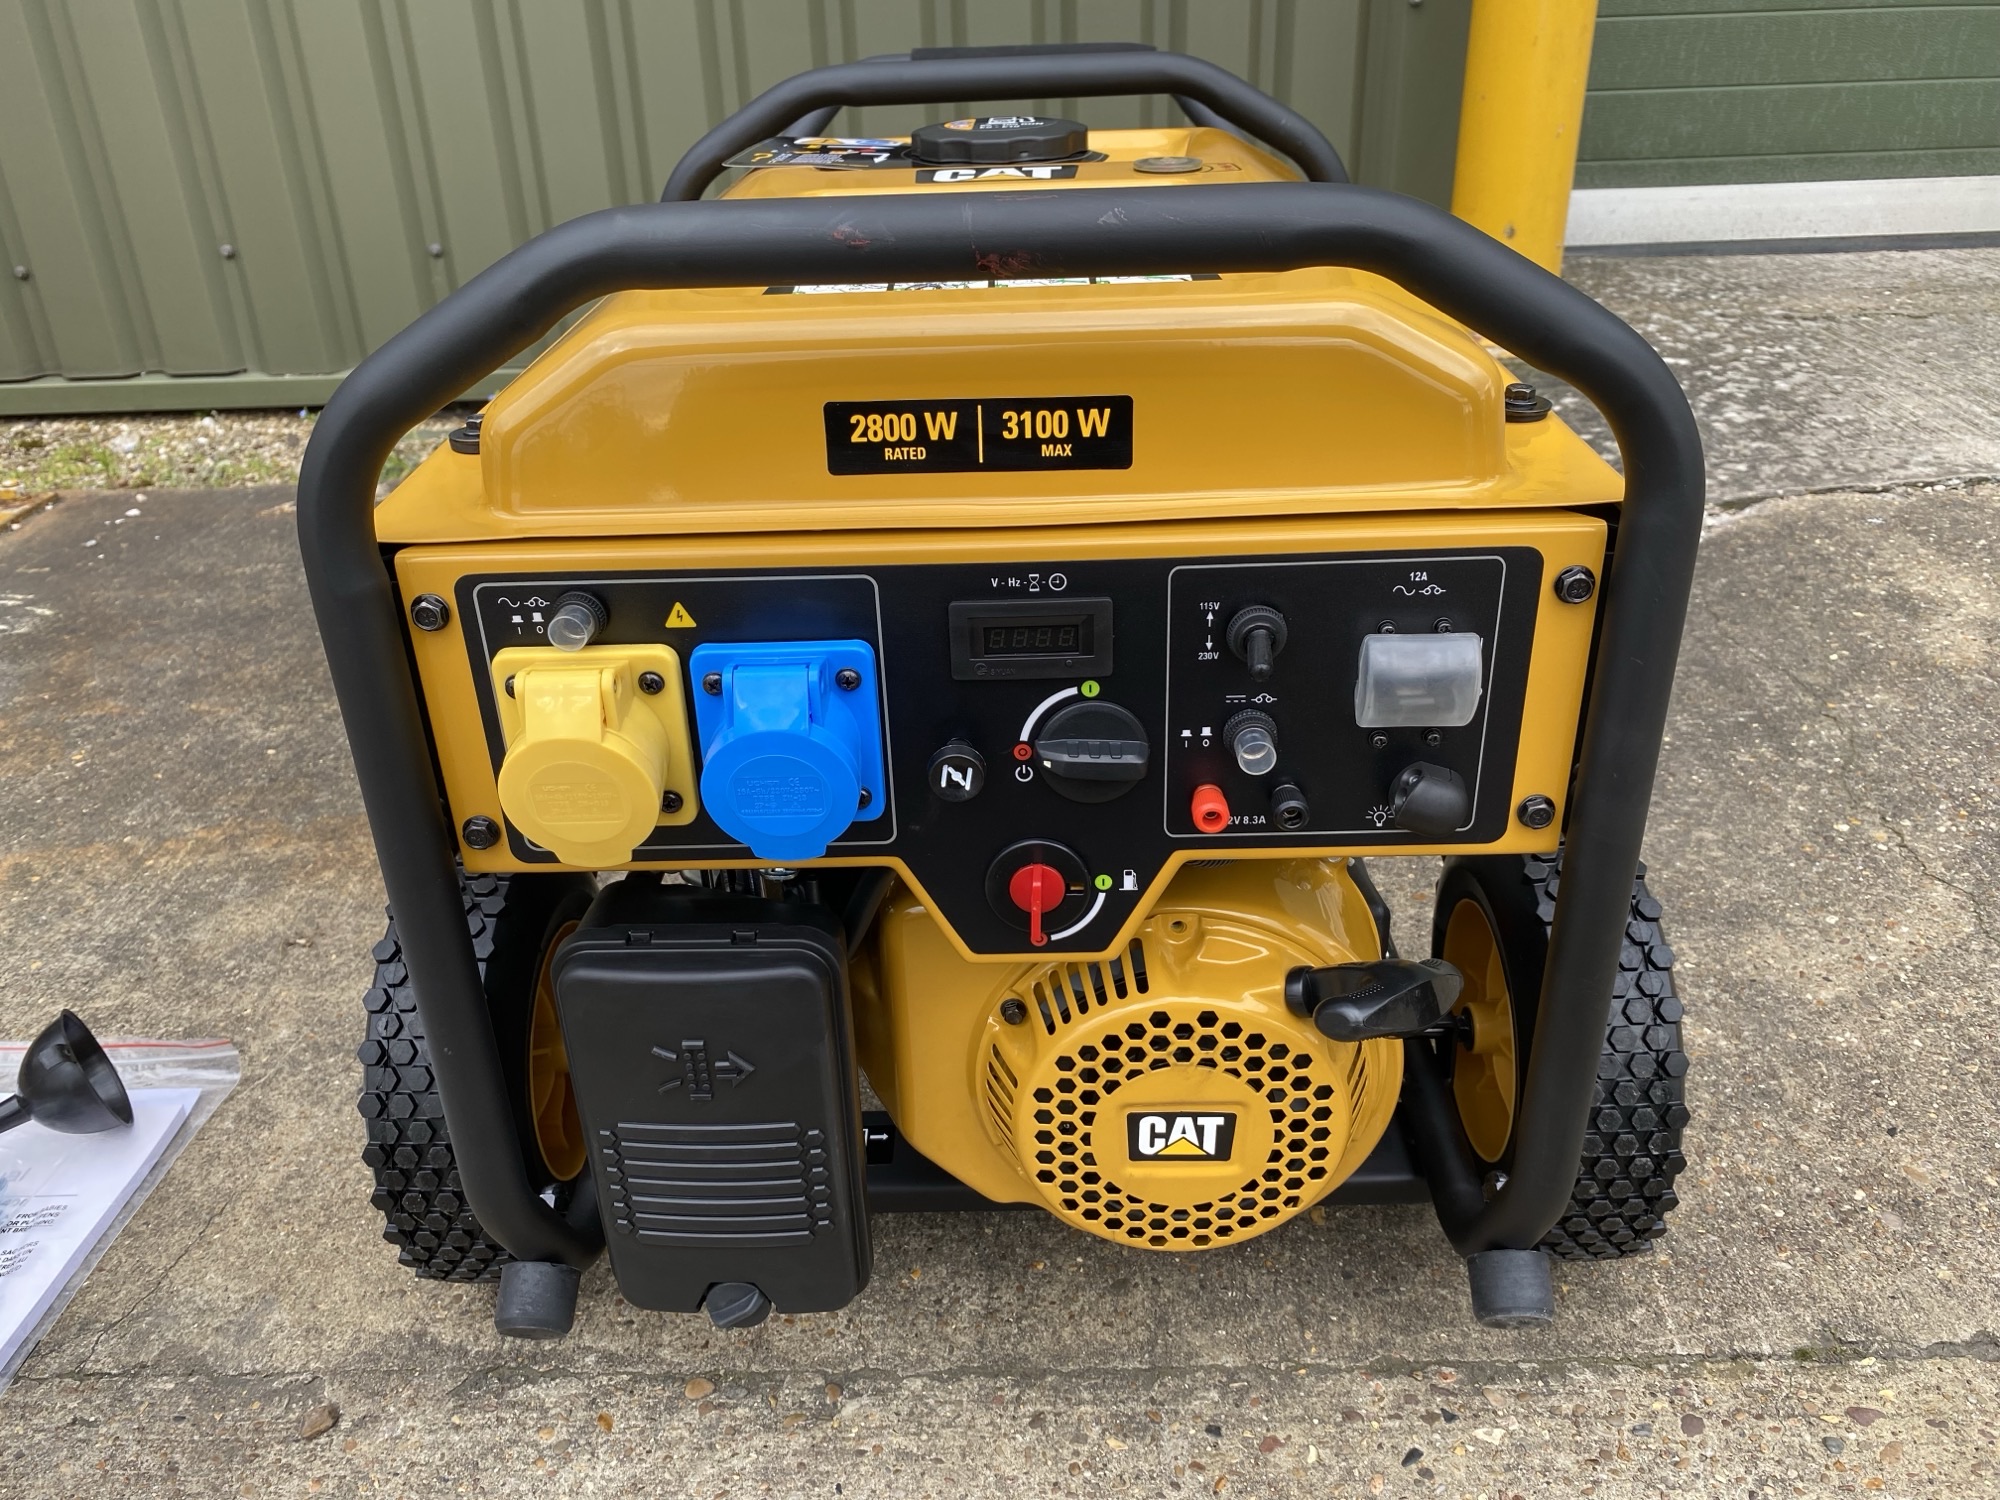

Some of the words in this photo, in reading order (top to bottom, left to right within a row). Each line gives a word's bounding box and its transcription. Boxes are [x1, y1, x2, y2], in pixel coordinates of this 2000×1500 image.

[933, 166, 1062, 182] CAT
[850, 414, 916, 443] 2800
[924, 412, 958, 440] W
[1002, 410, 1069, 439] 3100
[1077, 408, 1111, 437] W
[884, 447, 926, 460] RATED
[1041, 444, 1072, 457] MAX
[991, 578, 998, 588] V
[1008, 577, 1021, 588] Hz
[1409, 571, 1428, 581] 12A
[1200, 602, 1220, 610] 115V
[1198, 652, 1219, 660] 230V
[1228, 816, 1240, 825] 2V
[1243, 815, 1266, 824] 8.3A
[1140, 1118, 1224, 1155] CAT
